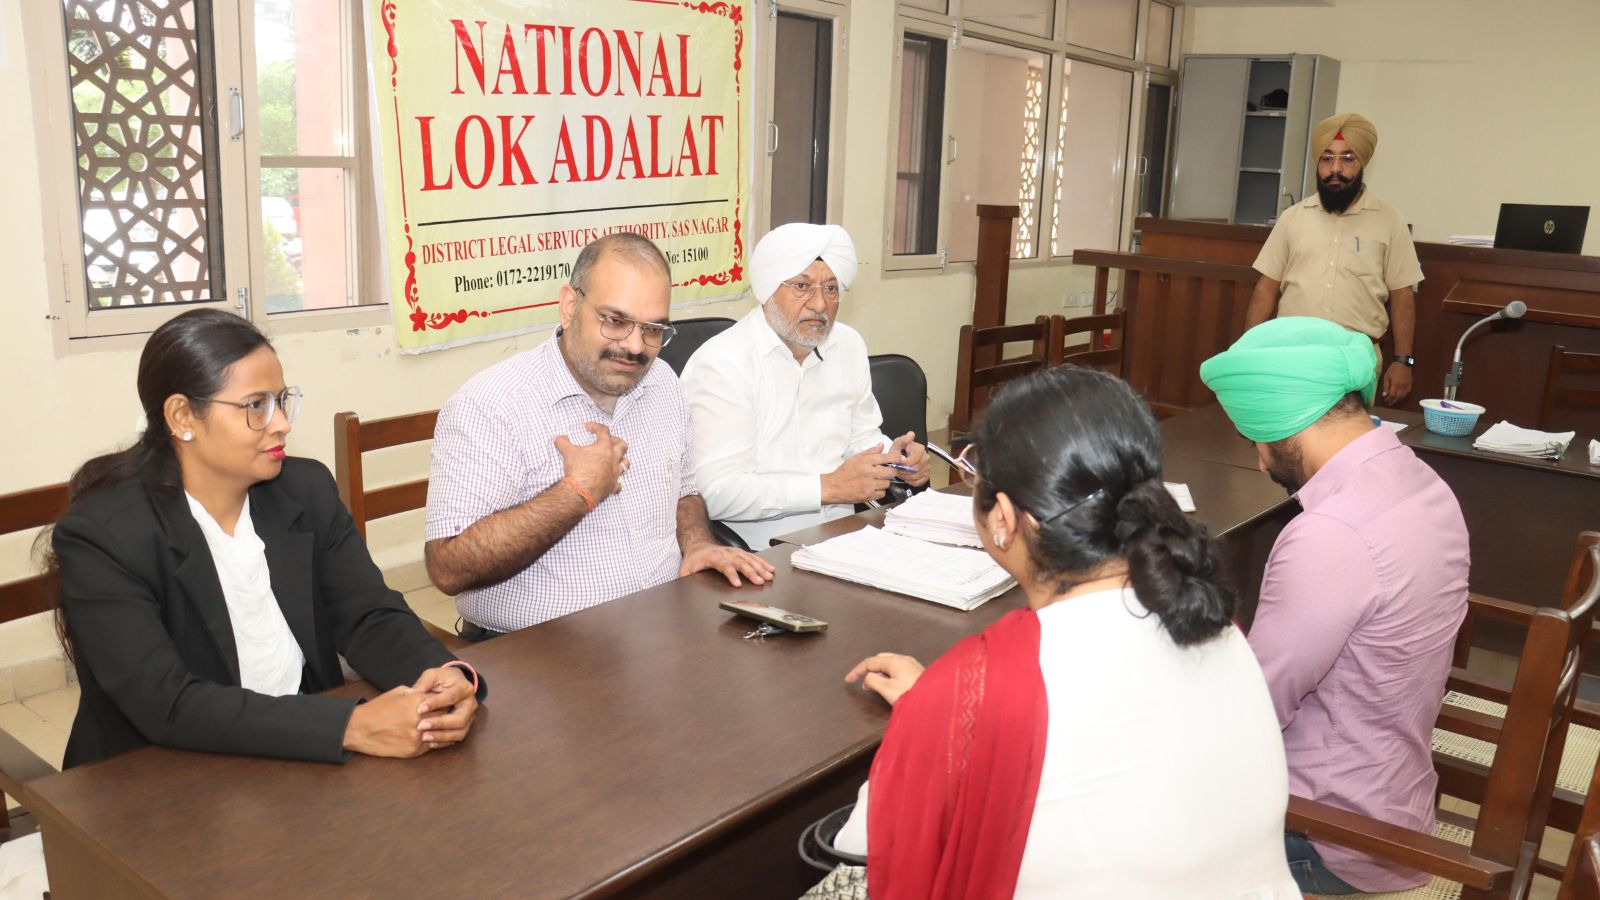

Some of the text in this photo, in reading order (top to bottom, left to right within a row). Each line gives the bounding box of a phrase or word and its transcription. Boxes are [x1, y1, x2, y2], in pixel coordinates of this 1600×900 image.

[450, 19, 702, 98] NATIONAL
[414, 114, 724, 191] LOK ADALAT
[422, 239, 486, 265] DISTRICT
[489, 233, 536, 257] LEGAL
[537, 227, 598, 252] SERVICES
[671, 220, 690, 238] SAS
[692, 216, 729, 236] NAGAR
[454, 275, 493, 293] Phone:
[496, 262, 571, 287] 0172-2219170
[682, 246, 709, 263] 15100
